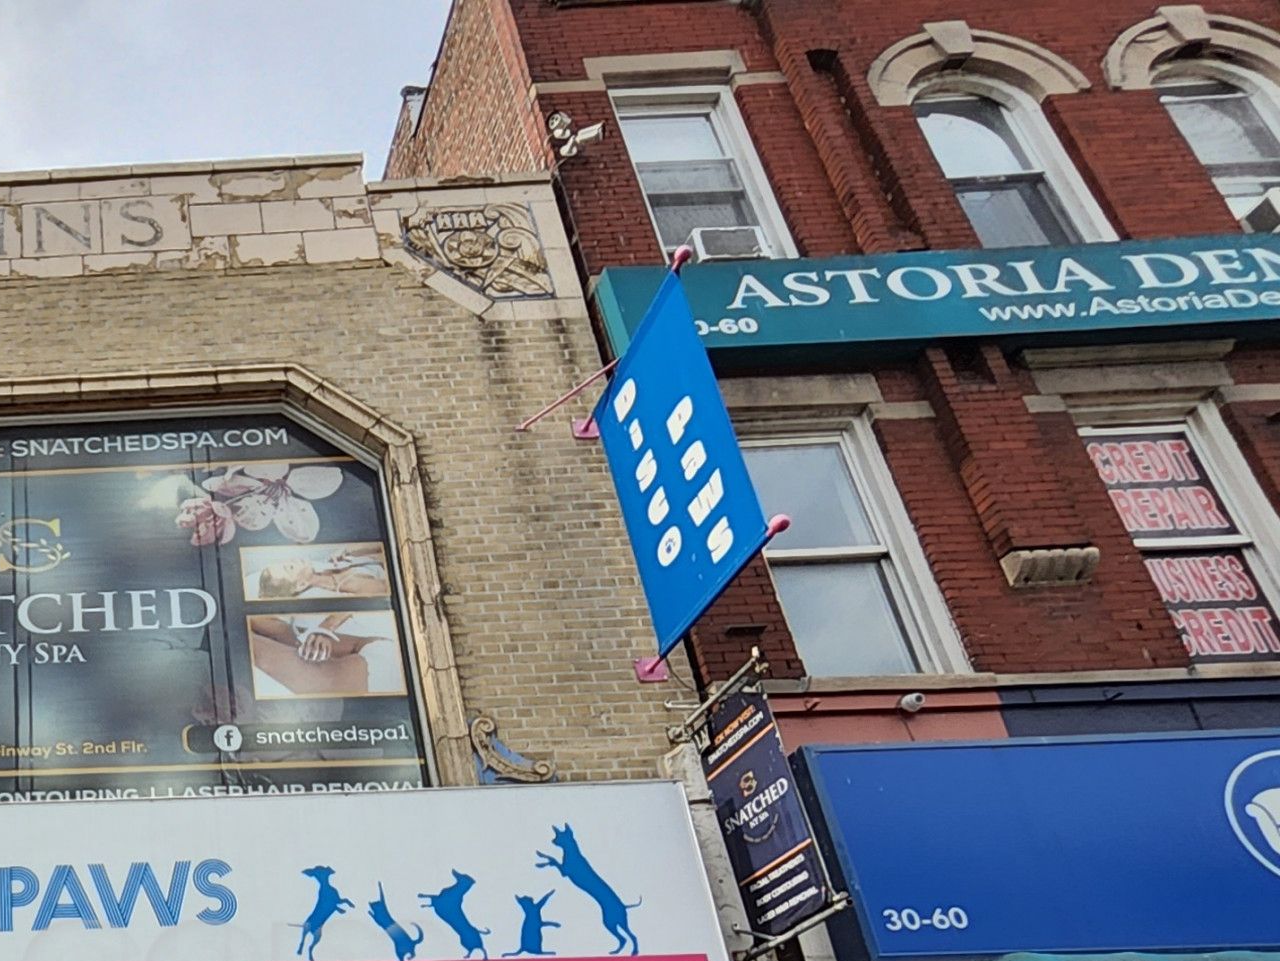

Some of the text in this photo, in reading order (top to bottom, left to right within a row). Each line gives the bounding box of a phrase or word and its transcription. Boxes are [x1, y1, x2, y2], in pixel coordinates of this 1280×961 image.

[726, 257, 1116, 310] ASTORIA
[695, 317, 759, 336] 0-60
[10, 428, 289, 458] SNATCHEDSPA.COM
[1087, 440, 1200, 484] CREDIT
[1108, 486, 1230, 532] REPAIR
[1144, 555, 1257, 603] USINESS
[35, 642, 86, 664] SPA
[56, 743, 78, 756] St.
[83, 742, 116, 755] 2nd
[724, 777, 789, 836] SNATCHED
[882, 906, 969, 932] 30-60
